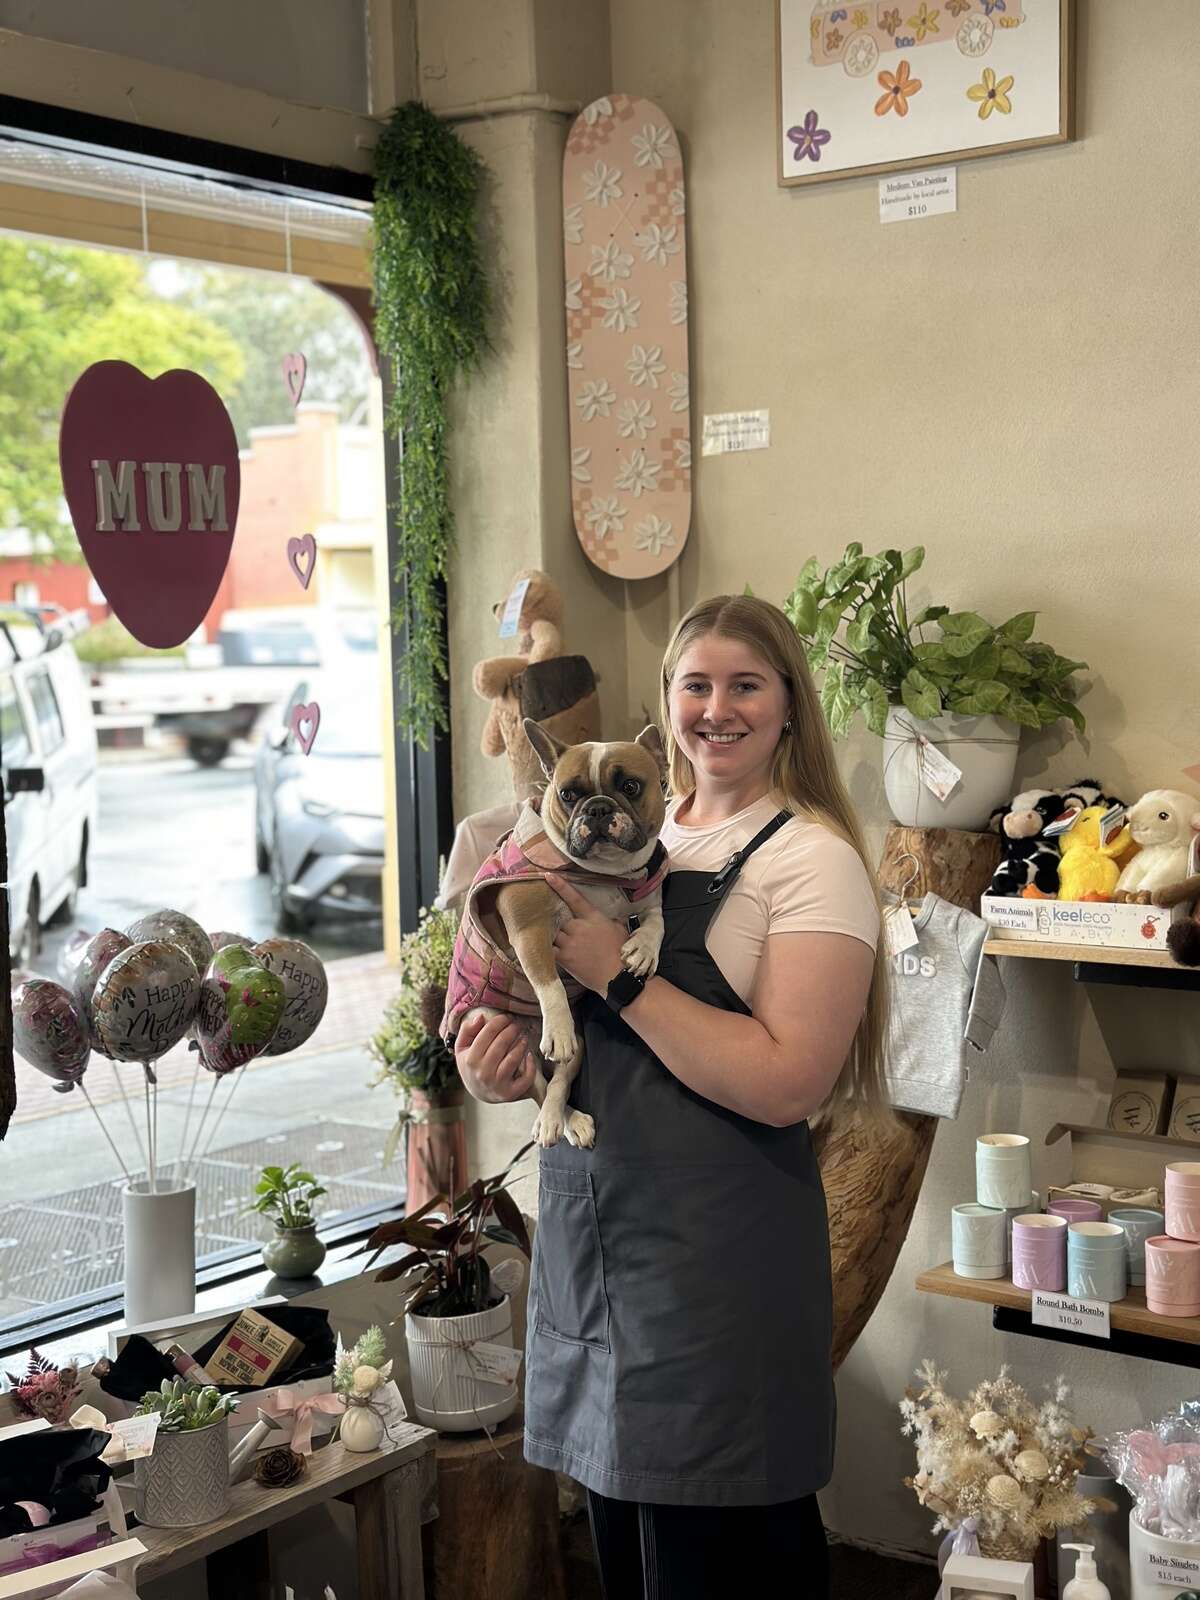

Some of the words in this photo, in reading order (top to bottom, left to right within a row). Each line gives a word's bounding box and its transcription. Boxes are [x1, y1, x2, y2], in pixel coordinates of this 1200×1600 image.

[908, 205, 927, 216] $110
[91, 460, 229, 531] MUM
[990, 905, 1008, 914] Farm
[1008, 907, 1034, 917] Animals
[1053, 906, 1111, 924] keeleco
[1011, 920, 1027, 928] Each
[1036, 1296, 1060, 1309] Round
[1061, 1301, 1078, 1312] Bath
[1080, 1304, 1105, 1317] Bombs
[1058, 1315, 1083, 1326] $10.50
[1149, 1554, 1168, 1567] Baby
[1170, 1558, 1199, 1570] Singlets
